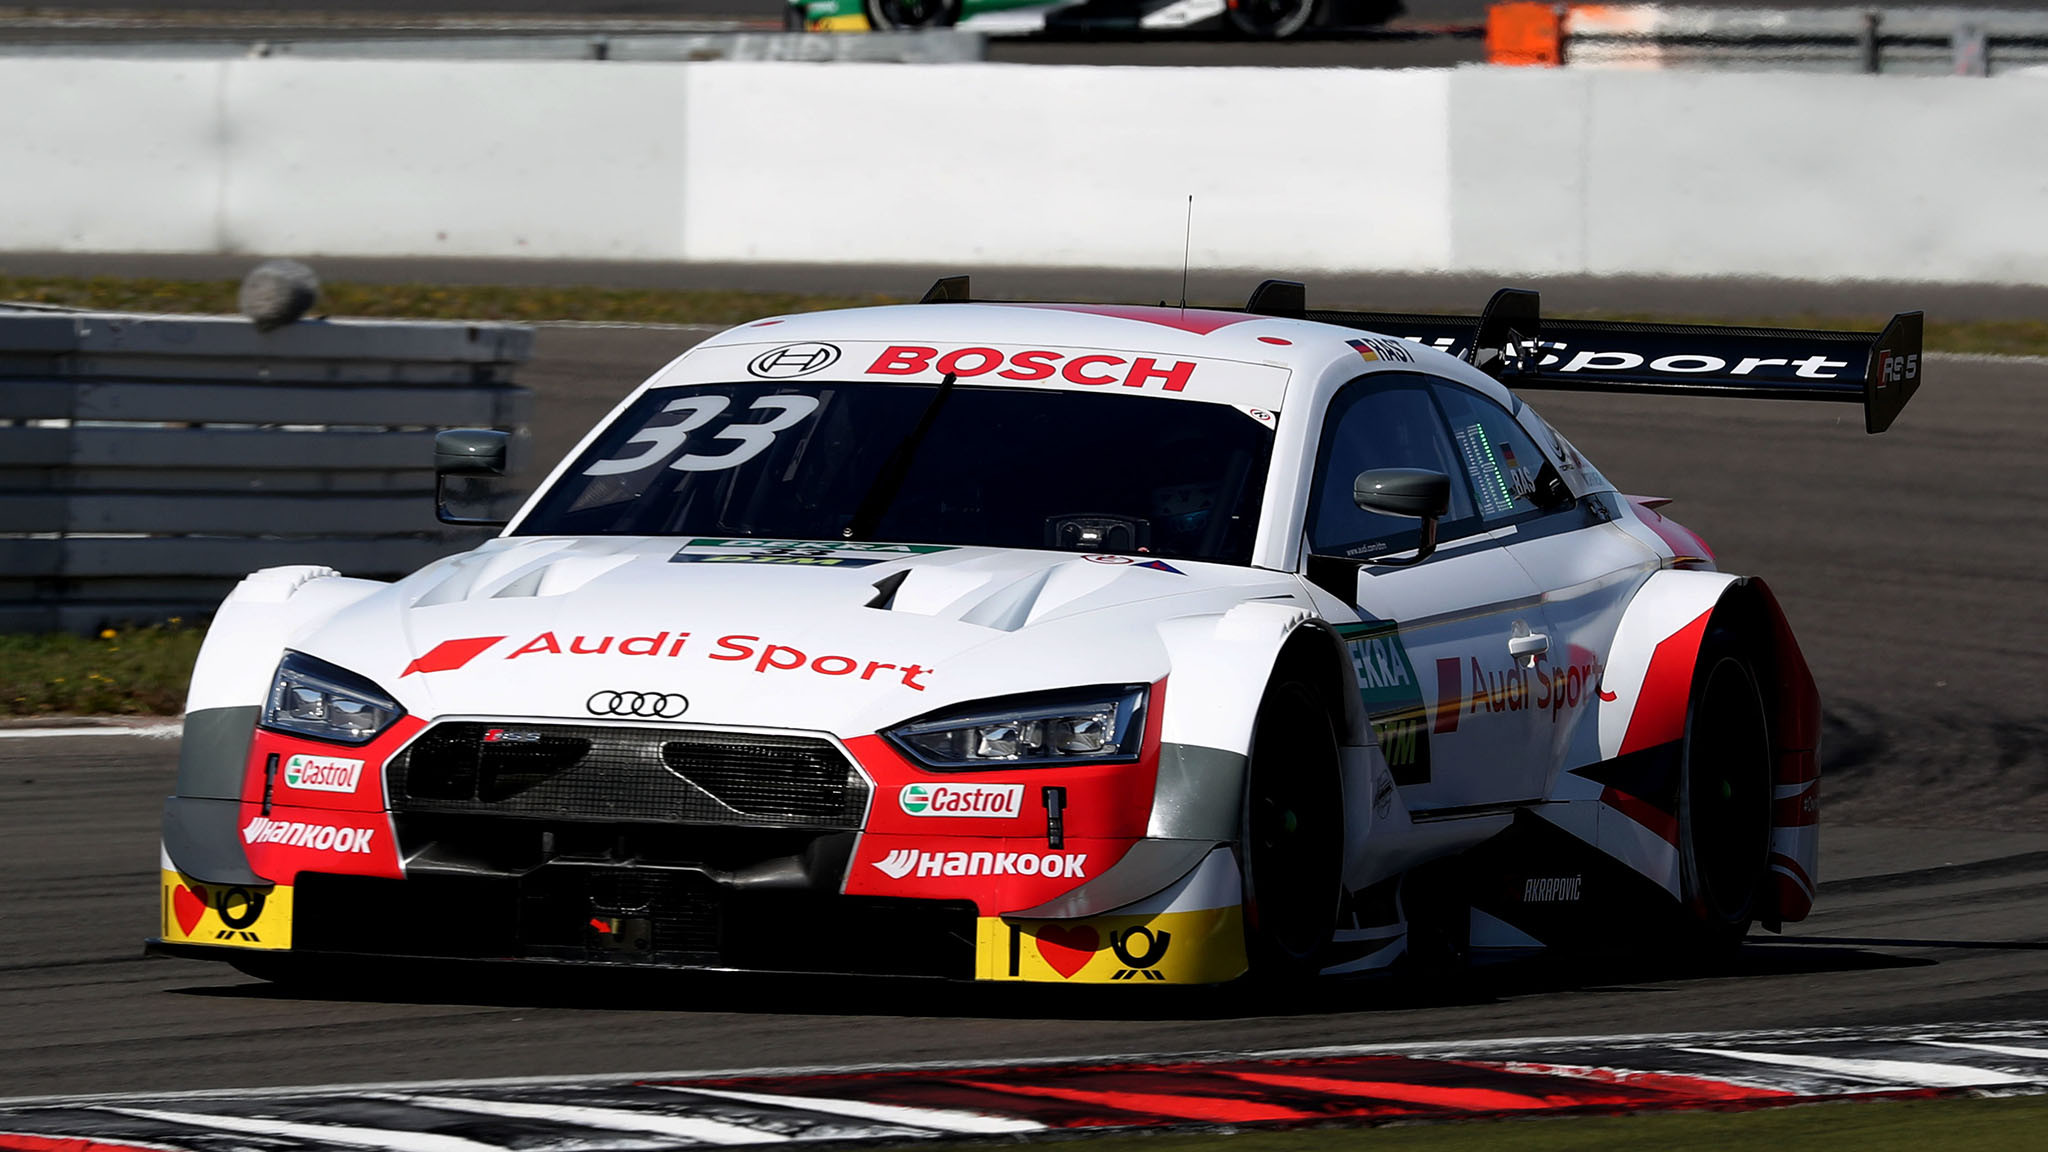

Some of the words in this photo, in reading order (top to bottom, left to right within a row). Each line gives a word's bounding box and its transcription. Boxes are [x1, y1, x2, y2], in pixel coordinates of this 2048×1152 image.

[1361, 338, 1415, 363] RAST
[867, 345, 1196, 392] BOSCH
[583, 394, 820, 476] 33
[1511, 466, 1537, 496] RAS
[702, 556, 843, 565] DTM
[718, 539, 912, 552] DEKRA
[507, 631, 690, 660] Audi
[709, 634, 933, 692] Sport
[1348, 636, 1411, 689] EKRA
[1470, 655, 1529, 714] Audi
[1534, 652, 1618, 723] Sport
[301, 759, 356, 788] Castrol
[931, 786, 1015, 812] Castrol
